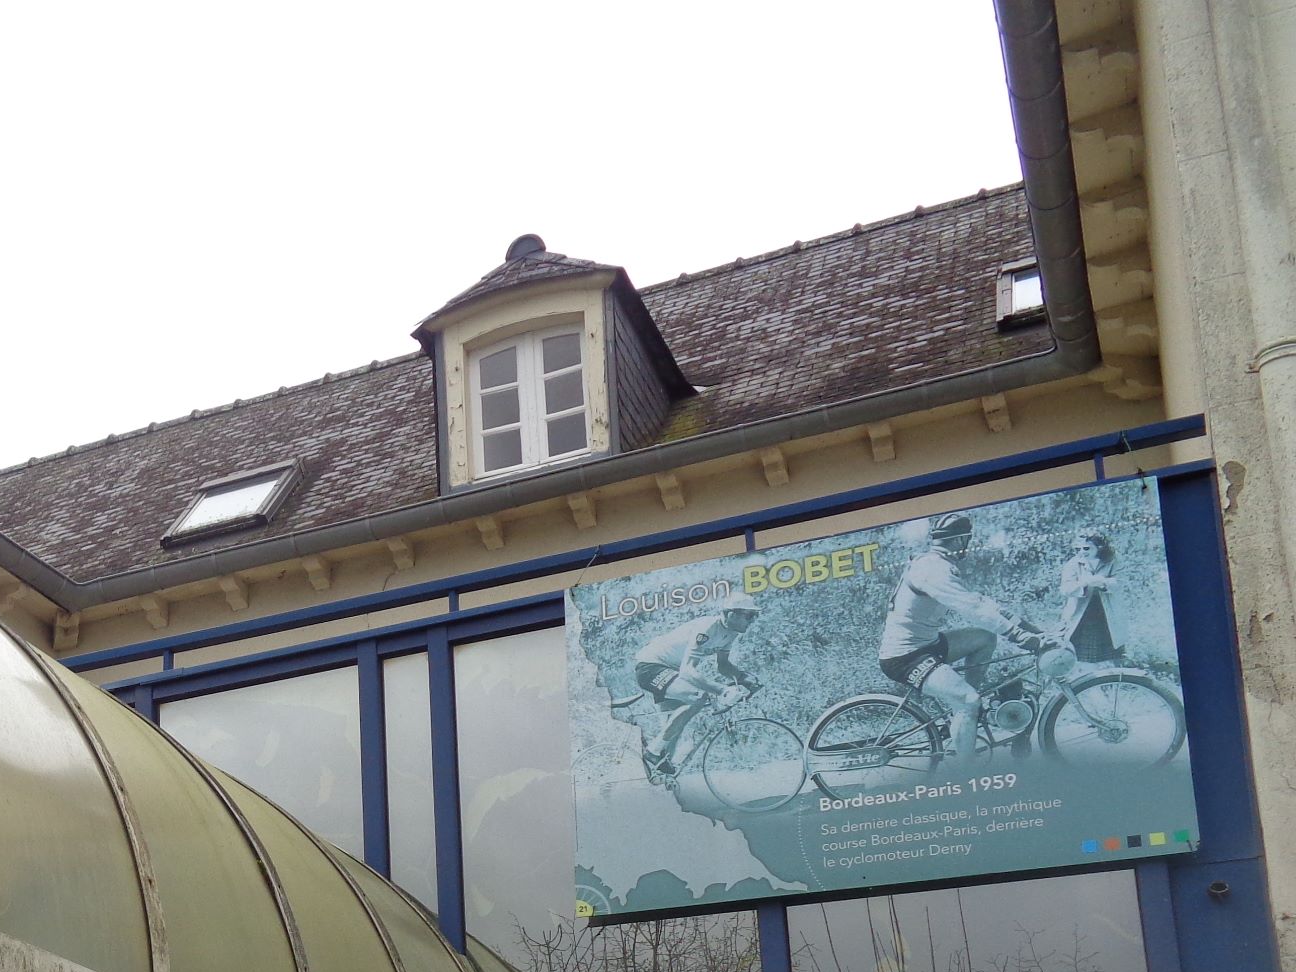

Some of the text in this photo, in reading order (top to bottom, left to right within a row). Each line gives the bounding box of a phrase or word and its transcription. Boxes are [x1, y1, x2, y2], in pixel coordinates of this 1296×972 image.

[600, 543, 880, 621] Louison BOBET
[819, 773, 1017, 812] Bordeaux-Paris 1959
[821, 797, 1062, 836] Sa dernière classique, la mythique
[822, 815, 1044, 852] course Bordeaux-Paris, derrière
[823, 841, 973, 868] le cyclomoteur Derny
[578, 905, 588, 913] 21
